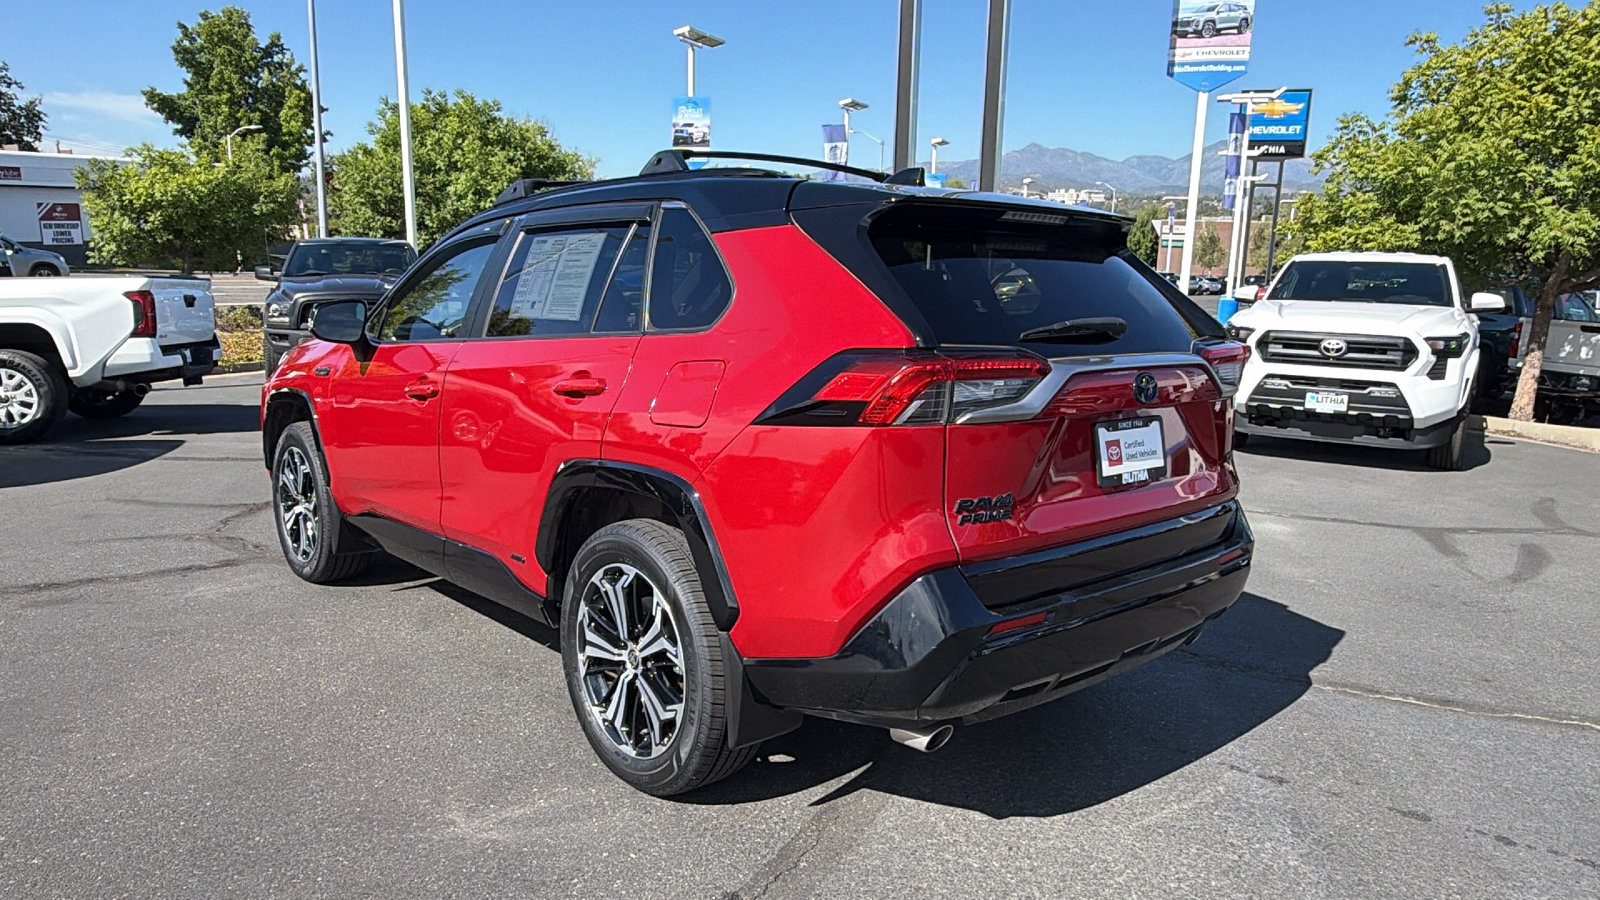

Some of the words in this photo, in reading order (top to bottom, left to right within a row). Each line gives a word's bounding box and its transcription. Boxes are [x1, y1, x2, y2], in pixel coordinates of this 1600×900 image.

[1249, 125, 1303, 135] HEVROLET
[1254, 145, 1286, 154] LHIA
[53, 222, 79, 230] OWNERSHIP
[1316, 396, 1345, 405] LITHIA
[1118, 421, 1132, 429] SINCE
[1124, 439, 1145, 449] Certified
[1125, 451, 1138, 460] Used
[1139, 448, 1157, 459] Vehicles
[954, 492, 1013, 514] RAV4
[957, 509, 1012, 526] PRIME
